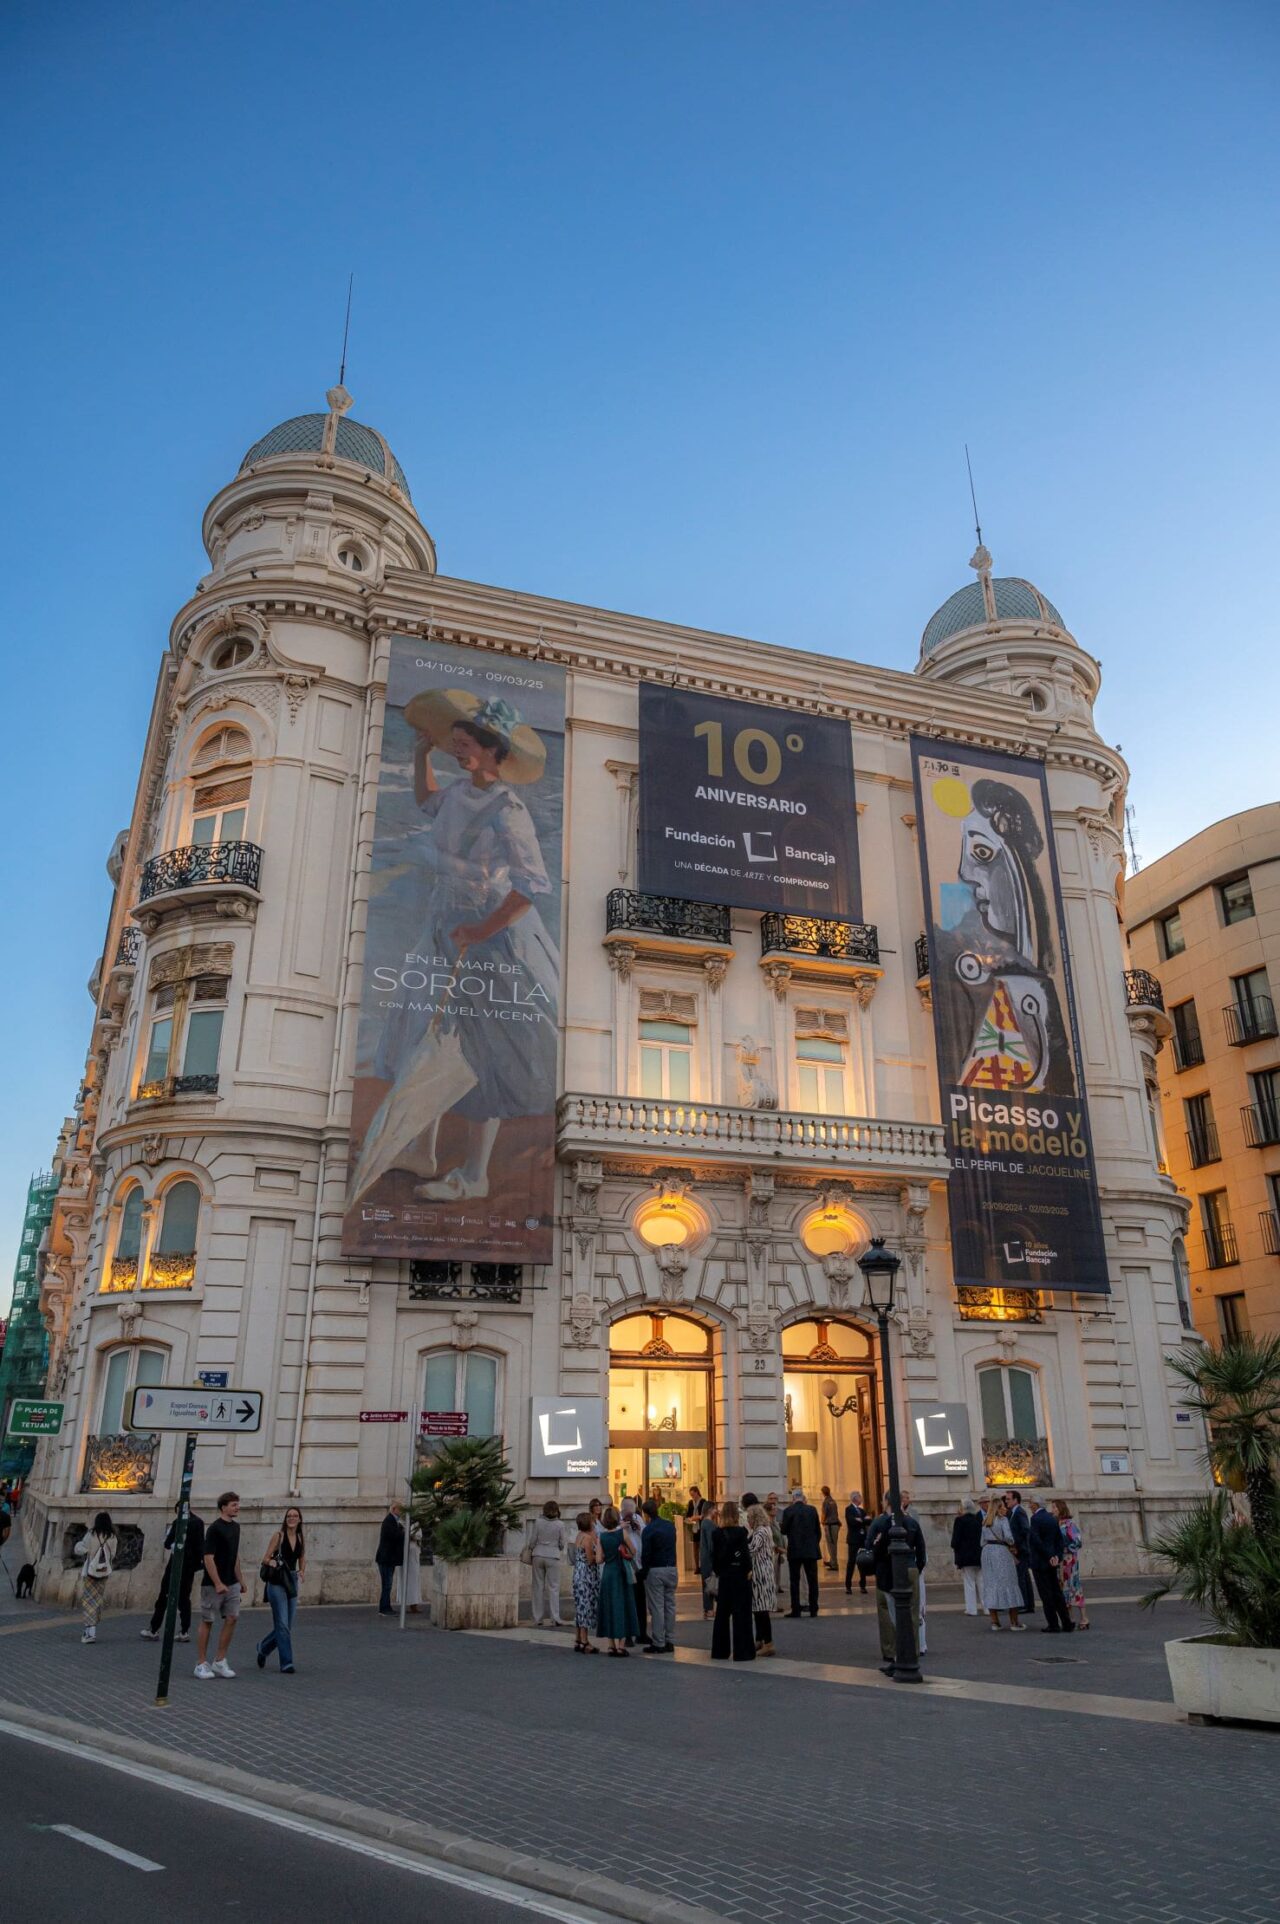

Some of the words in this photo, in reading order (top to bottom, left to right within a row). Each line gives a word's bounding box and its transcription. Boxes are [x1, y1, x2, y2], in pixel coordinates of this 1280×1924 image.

[415, 658, 473, 677] 04/10/24
[486, 671, 544, 689] 09/03/25
[695, 785, 807, 815] ANIVERSARIO
[665, 827, 736, 849] Fundación
[785, 846, 836, 866] Bancaja
[674, 860, 693, 870] UNA
[694, 861, 729, 876] DÉCADA
[730, 868, 742, 878] DE
[742, 870, 765, 882] ARTE
[766, 873, 772, 882] Y
[773, 874, 830, 891] COMPROMISO
[405, 953, 429, 965] EN
[433, 956, 454, 967] EL
[455, 959, 495, 972] MAR
[499, 963, 524, 975] DE
[371, 966, 550, 1006] SOROLLA
[408, 1001, 479, 1018] MANUEL
[483, 1008, 545, 1024] VICENT
[950, 1093, 1059, 1130] Picasso
[1066, 1111, 1082, 1138] y
[951, 1120, 976, 1149] la
[987, 1128, 1087, 1159] modelo
[955, 1157, 968, 1169] EL
[970, 1159, 1008, 1173] PERFIL
[1009, 1162, 1025, 1174] DE
[1026, 1164, 1091, 1180] JACQUELINE
[1025, 1248, 1058, 1258] Fundación
[1025, 1256, 1051, 1265] Bancaja
[754, 1359, 766, 1371] 23
[21, 1421, 50, 1429] TETUAN
[566, 1465, 591, 1474] Bancaja
